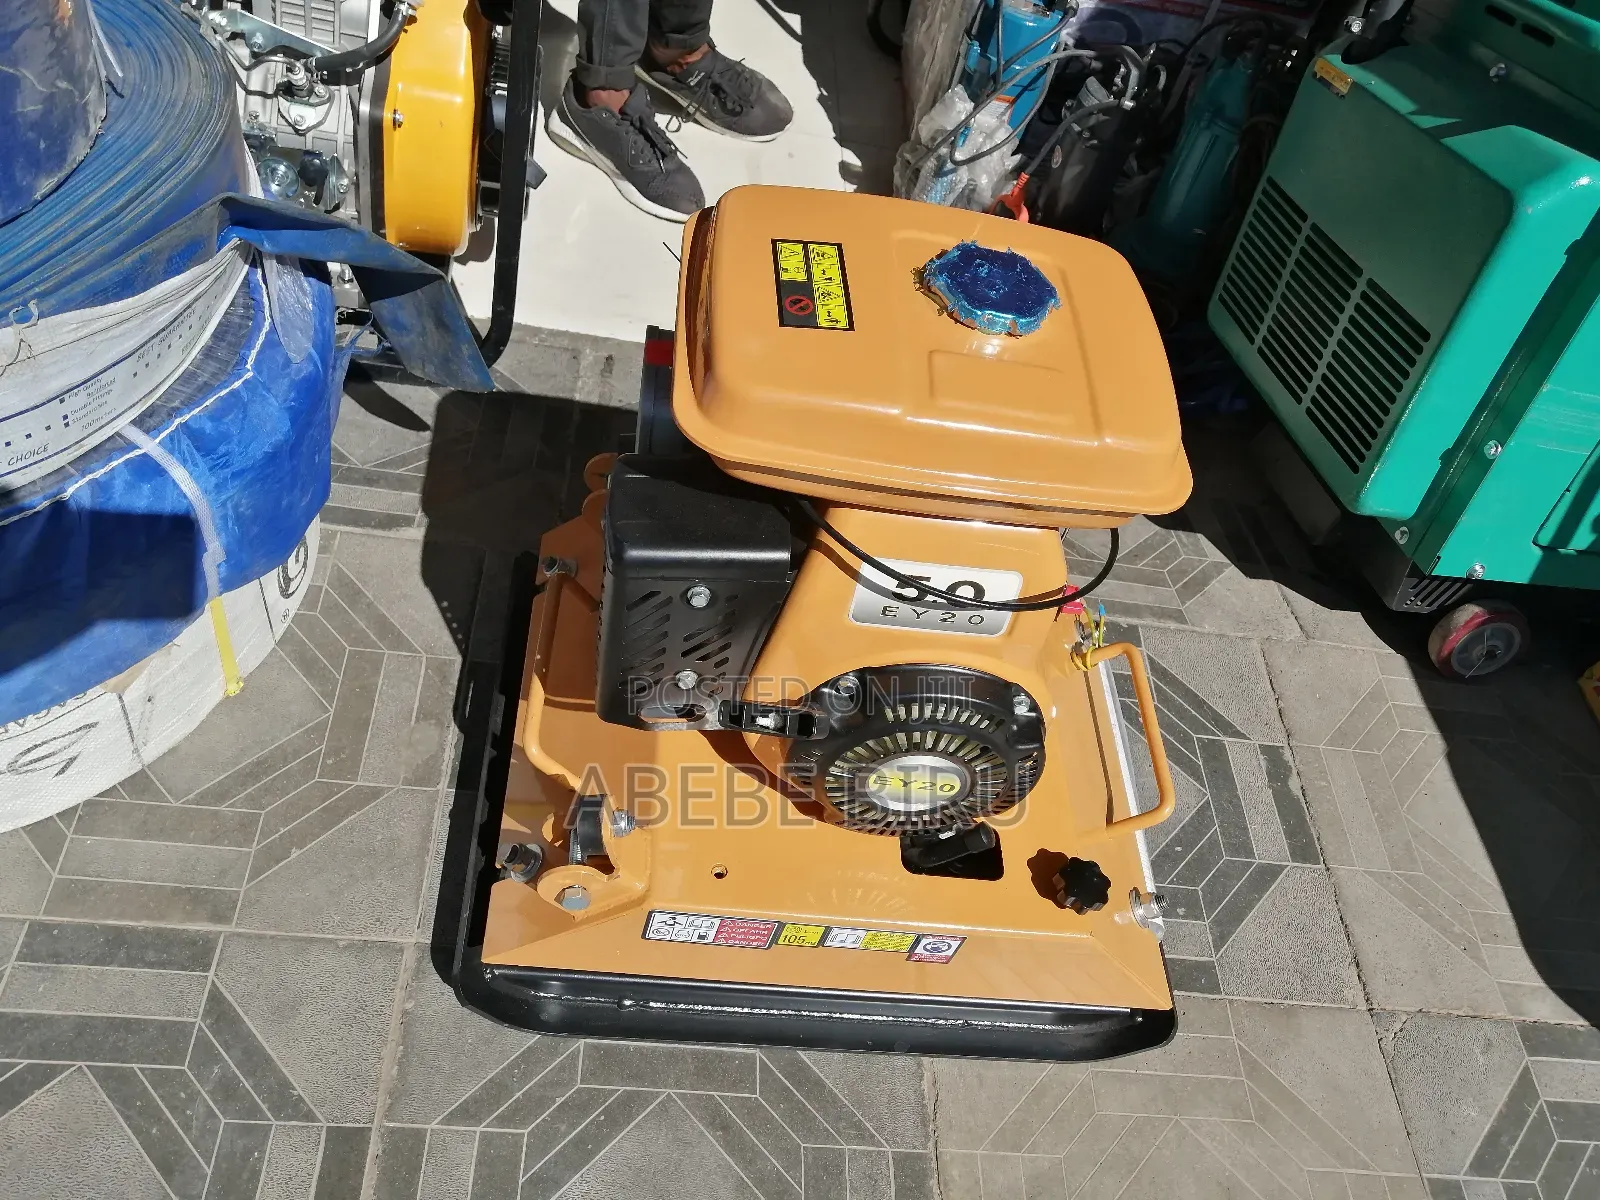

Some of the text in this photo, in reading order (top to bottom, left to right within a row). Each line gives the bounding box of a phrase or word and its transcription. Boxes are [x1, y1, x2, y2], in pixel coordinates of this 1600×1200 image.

[8, 443, 50, 466] CHOICE
[880, 604, 985, 626] EY20
[872, 775, 956, 793] EY20
[782, 934, 807, 945] 105
